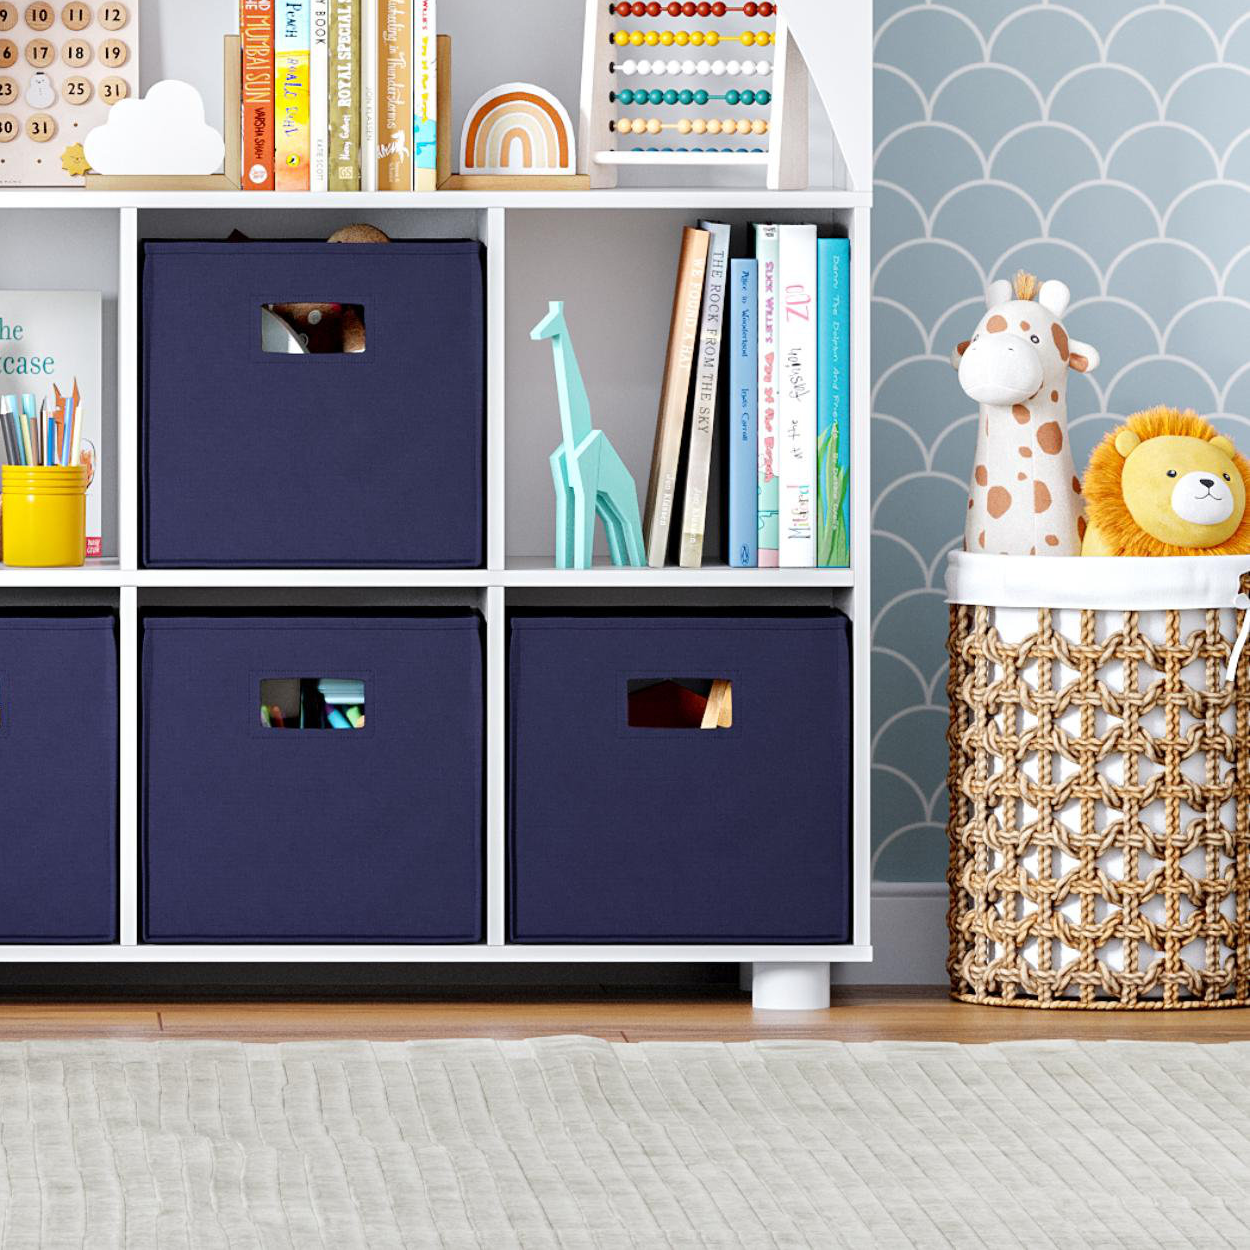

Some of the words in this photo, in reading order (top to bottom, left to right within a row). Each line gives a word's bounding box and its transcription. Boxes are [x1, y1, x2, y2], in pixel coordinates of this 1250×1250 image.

[0, 10, 7, 22] 9
[32, 9, 48, 22] 10
[68, 9, 83, 21] 11
[104, 9, 120, 21] 12
[314, 10, 326, 45] BOOK
[244, 15, 270, 70] MUMBAI
[337, 5, 352, 60] SPECIAL
[32, 47, 48, 59] 17
[68, 46, 83, 58] 18
[105, 46, 120, 58] 19
[67, 83, 84, 95] 25
[104, 84, 120, 97] 31
[244, 72, 271, 103] SUN
[337, 63, 352, 108] ROYAL
[386, 51, 407, 130] Thunderstorms
[32, 122, 48, 134] 31
[253, 106, 266, 137] VARSHA
[365, 106, 373, 142] KLASSEN
[691, 257, 704, 276] WE
[711, 250, 725, 278] THE
[685, 282, 701, 327] FOUND
[707, 283, 722, 323] ROCK
[679, 345, 692, 370] HAT
[703, 328, 718, 368] FROM
[700, 373, 714, 401] THE
[697, 406, 711, 434] SKY
